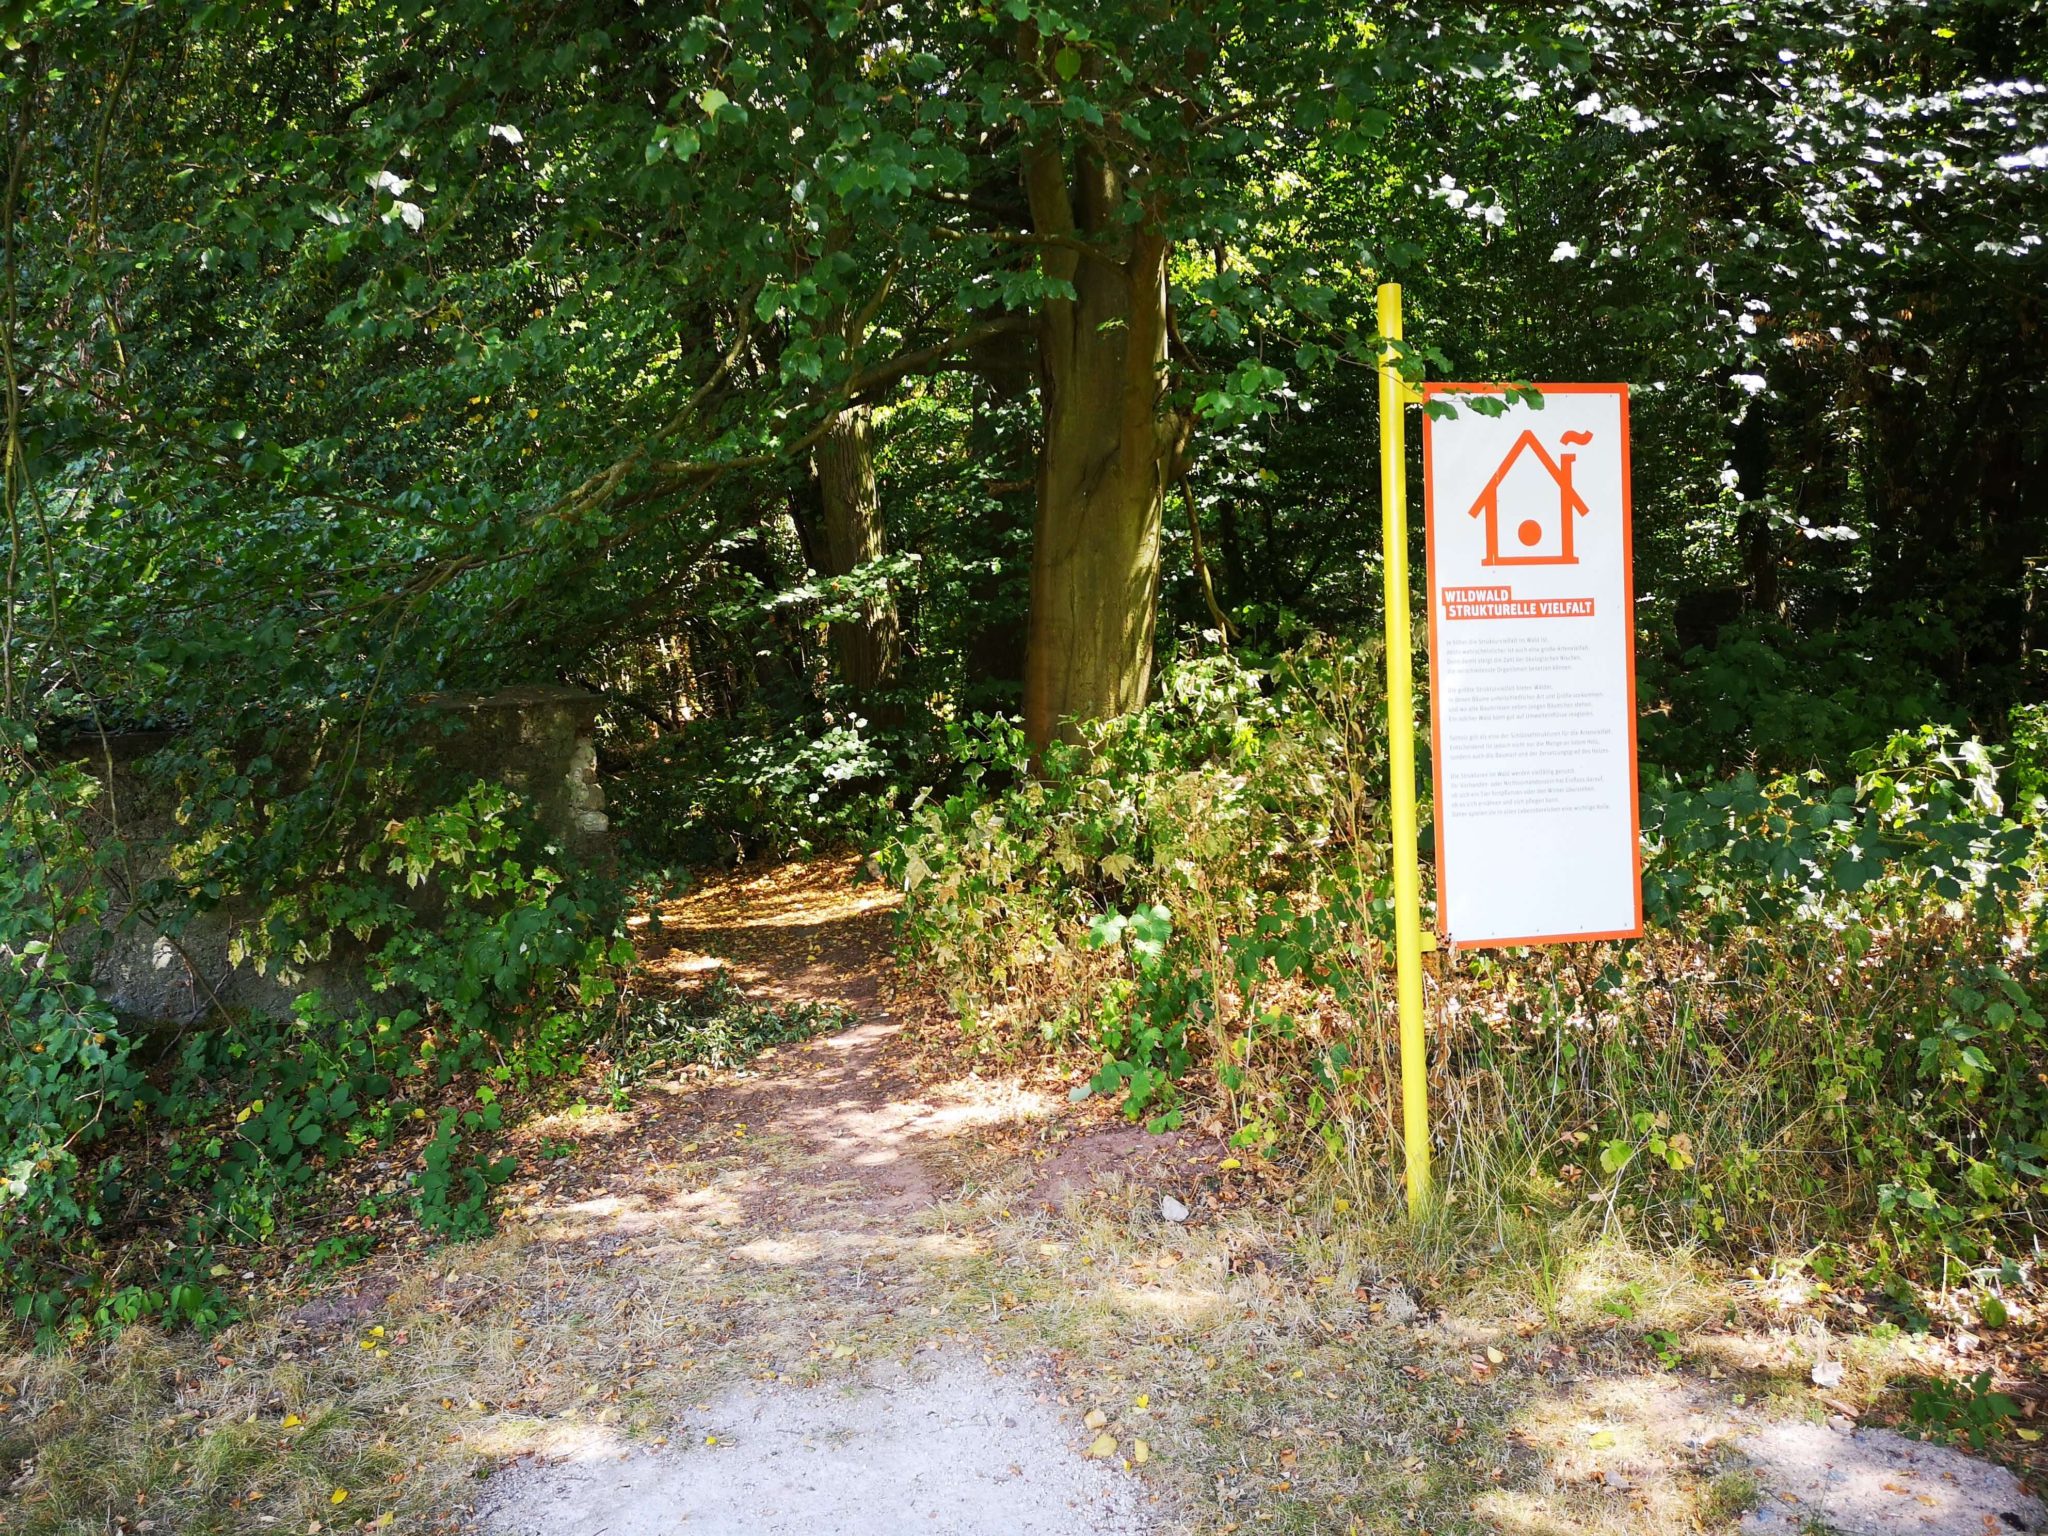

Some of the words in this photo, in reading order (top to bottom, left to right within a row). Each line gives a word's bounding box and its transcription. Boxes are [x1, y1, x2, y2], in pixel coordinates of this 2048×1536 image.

[1445, 589, 1509, 603] WILDWALD
[1448, 603, 1537, 618] STRUKTURELLE
[1539, 601, 1592, 615] VIELFALT
